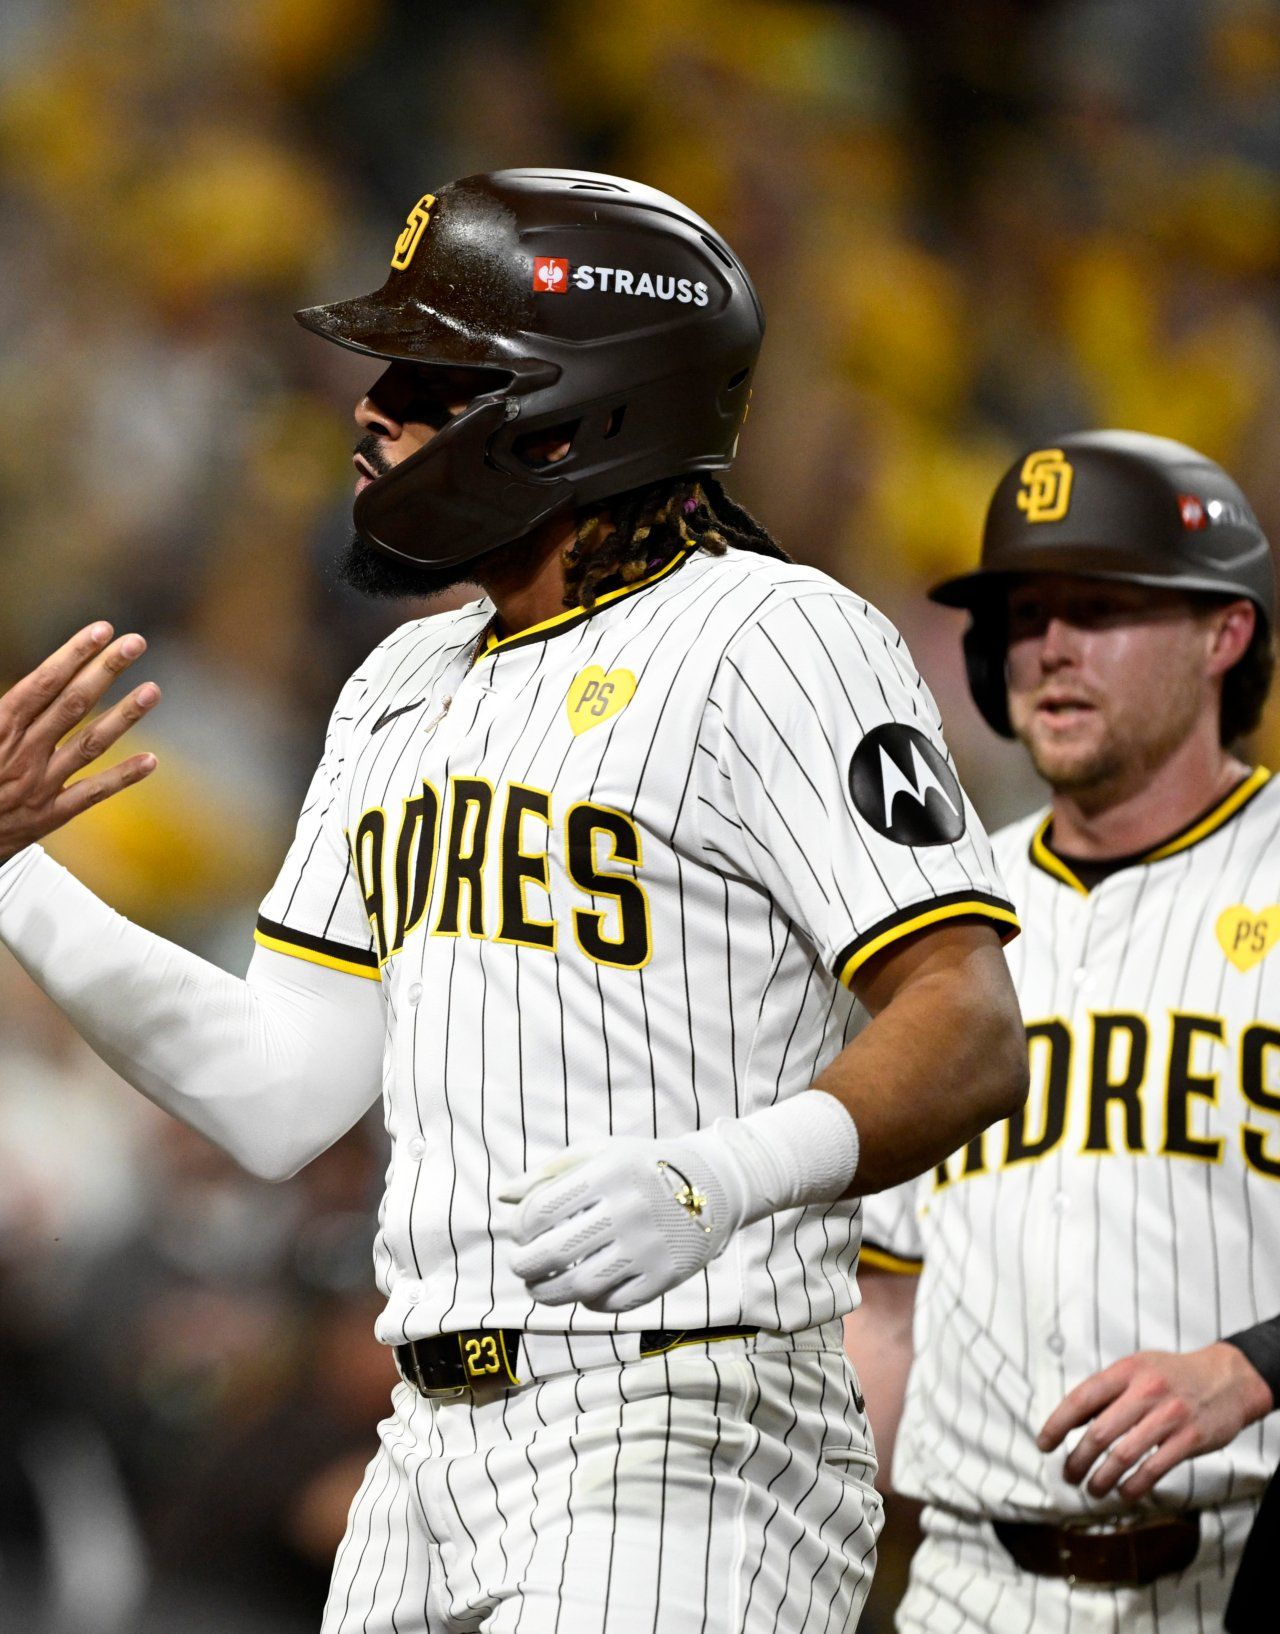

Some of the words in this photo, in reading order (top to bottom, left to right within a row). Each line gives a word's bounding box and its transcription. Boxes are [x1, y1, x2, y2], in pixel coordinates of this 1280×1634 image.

[574, 264, 709, 307] STRAUSS
[574, 680, 615, 717] PS
[343, 775, 653, 971] ADRES
[1233, 920, 1269, 953] PS
[932, 1008, 1280, 1194] DRES
[464, 1336, 501, 1377] 23
